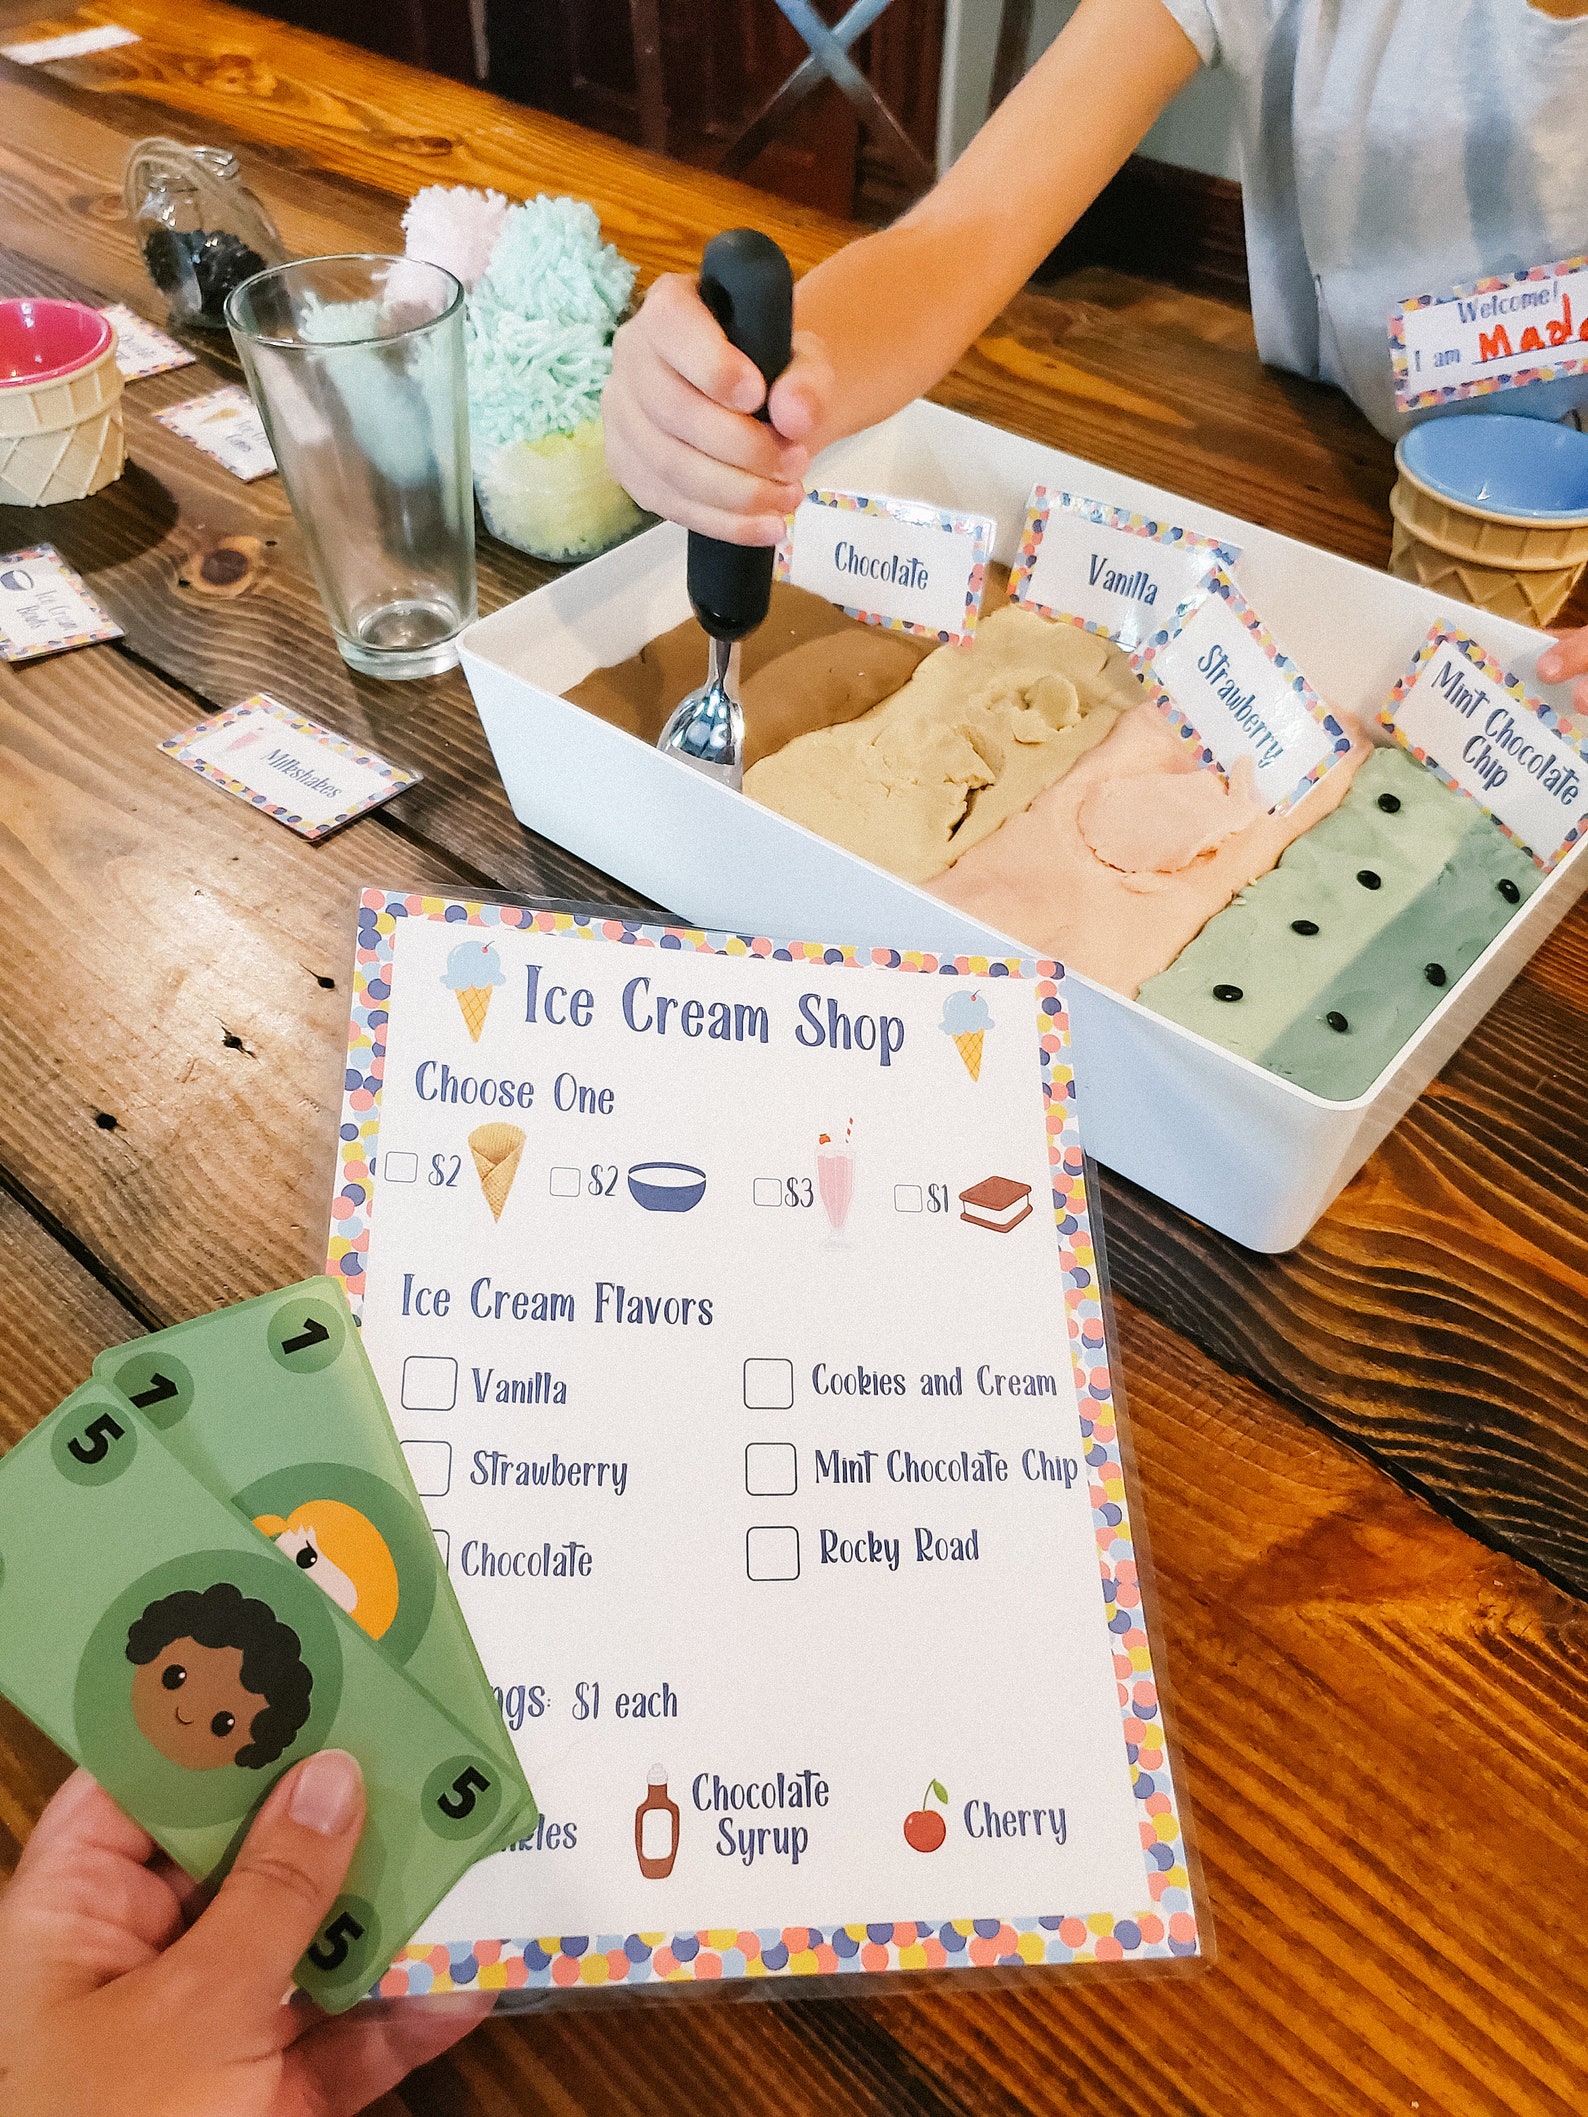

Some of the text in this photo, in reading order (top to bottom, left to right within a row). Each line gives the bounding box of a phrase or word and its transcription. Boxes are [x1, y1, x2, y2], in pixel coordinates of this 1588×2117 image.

[1456, 279, 1559, 325] Welcome!
[1414, 348, 1461, 373] I am
[834, 541, 929, 590] Chocolate
[1088, 553, 1159, 606] Vanilla
[1197, 643, 1285, 770] Strawberry
[1430, 660, 1581, 806] Mint Chocolate
[259, 747, 343, 799] Milkshakes
[1461, 734, 1509, 792] Chip
[524, 964, 905, 1067] Ice Cream Shop
[415, 1060, 615, 1115] Choose One
[428, 1153, 462, 1188] $2
[587, 1163, 619, 1197] $2
[784, 1176, 815, 1208] $3
[927, 1182, 949, 1214] $1
[401, 1273, 714, 1326] Ice Cream Flavors
[280, 1317, 331, 1356] 1
[471, 1367, 567, 1405] Vanilla
[811, 1362, 1058, 1397] Cookies and Cream
[66, 1412, 126, 1465] 5
[469, 1449, 628, 1497] Strawberry
[814, 1448, 1079, 1490] Mint Chocolate Chip
[460, 1539, 593, 1578] Chocolate
[819, 1527, 980, 1572] Rocky Road
[571, 1681, 600, 1721] $1
[615, 1682, 678, 1719] each
[436, 1764, 492, 1820] 5
[691, 1769, 830, 1812] Chocolate
[715, 1816, 809, 1867] Syrup
[963, 1799, 1067, 1846] Cherry
[306, 1910, 367, 1972] 5
